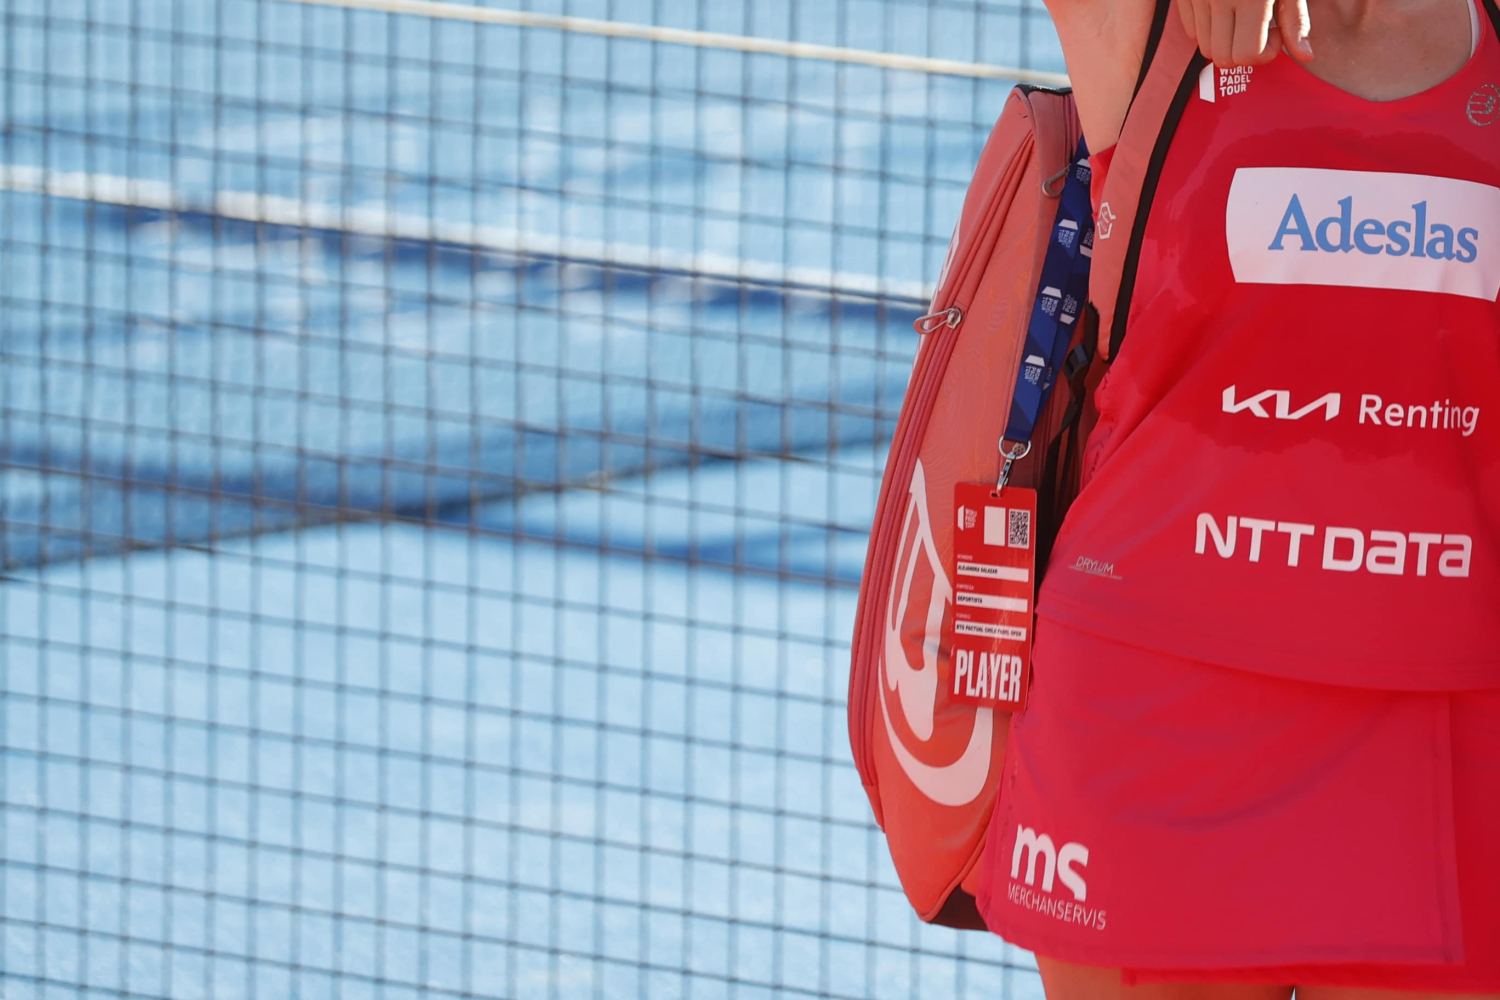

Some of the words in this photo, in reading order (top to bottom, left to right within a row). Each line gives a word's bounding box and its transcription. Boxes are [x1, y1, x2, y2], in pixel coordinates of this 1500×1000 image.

[1219, 65, 1254, 76] WORLD
[1219, 74, 1251, 87] PADEL
[1219, 83, 1247, 97] TOUR
[1267, 193, 1479, 264] Adeslas
[1222, 384, 1341, 421] KIA
[1358, 394, 1480, 436] Renting
[1194, 512, 1316, 567] NTT
[953, 649, 1023, 703] PLAYER
[1007, 881, 1107, 931] MERCHANSERVIS
